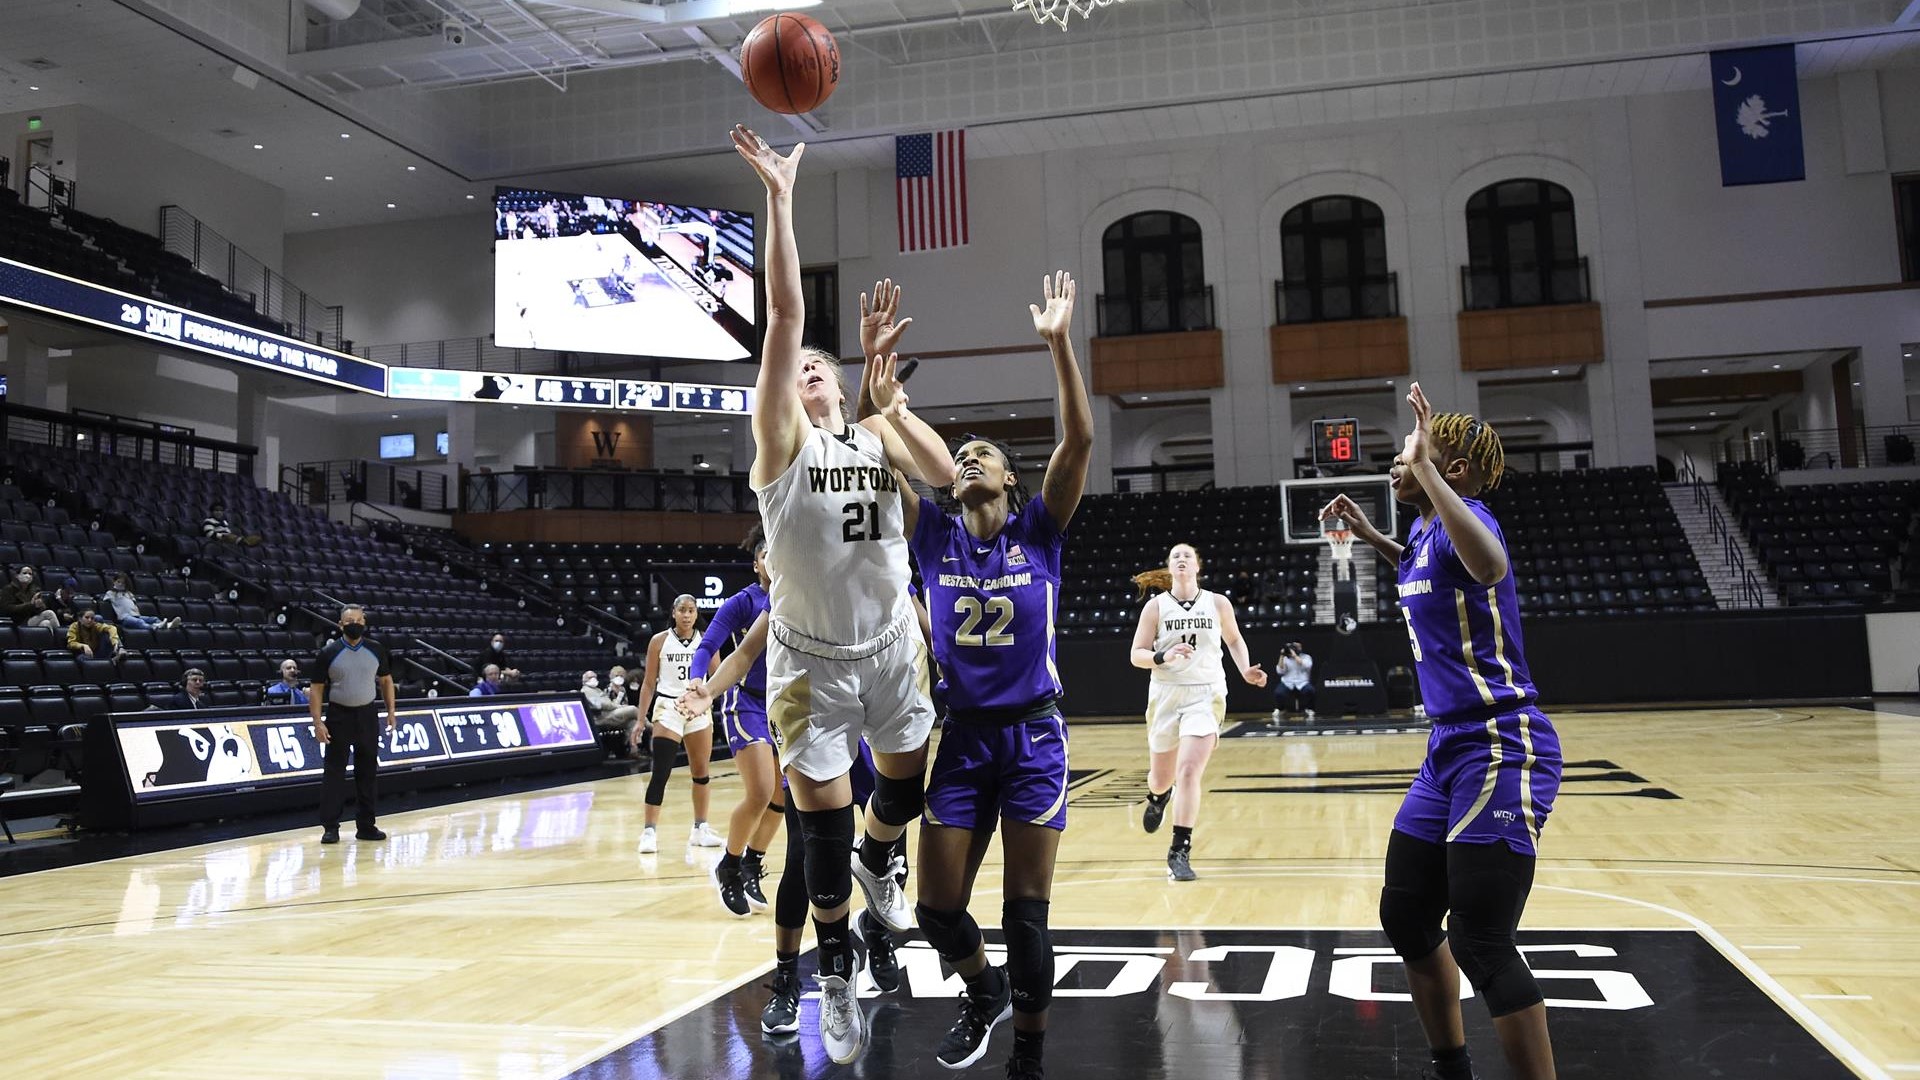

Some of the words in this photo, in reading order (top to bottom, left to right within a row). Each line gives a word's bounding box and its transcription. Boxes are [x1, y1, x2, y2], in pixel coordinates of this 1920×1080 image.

[184, 320, 258, 355] FRESHMAN
[260, 341, 278, 359] OF
[279, 346, 304, 367] THE
[305, 353, 337, 376] YEAR
[592, 431, 621, 457] W
[1331, 438, 1351, 459] 18
[842, 501, 882, 542] 21
[939, 573, 980, 589] WESTERN
[982, 572, 1031, 591] CAROLINA
[954, 596, 1015, 646] 22
[1164, 618, 1213, 631] WOFFORD
[1181, 633, 1197, 651] 14
[454, 726, 464, 743] 2
[530, 703, 580, 740] WCU
[266, 726, 305, 769] 45
[386, 722, 430, 754] 2:20
[1493, 810, 1516, 822] WCU
